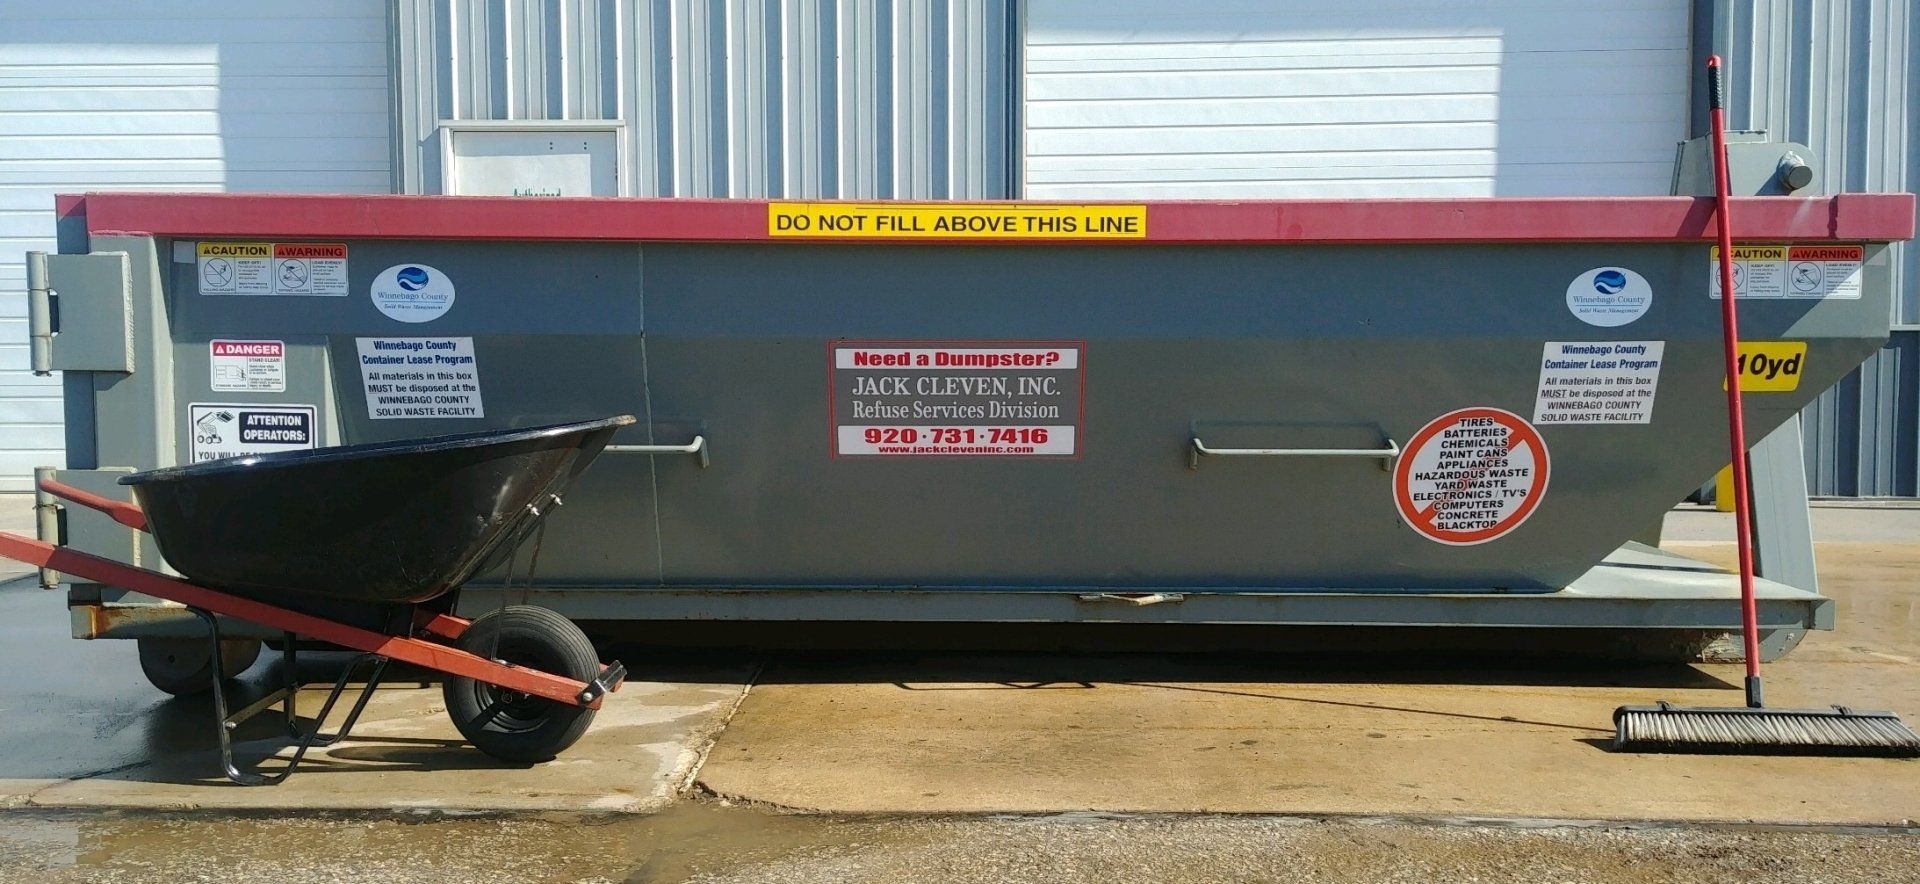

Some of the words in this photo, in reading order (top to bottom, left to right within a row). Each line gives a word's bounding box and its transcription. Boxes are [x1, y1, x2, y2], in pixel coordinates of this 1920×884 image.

[776, 215, 810, 231] DO
[819, 215, 868, 231] NOT
[876, 215, 925, 231] FILL
[933, 216, 1018, 232] ABOVE
[1023, 216, 1077, 233] THIS
[1086, 217, 1138, 233] LINE
[211, 246, 267, 255] CAUTION
[284, 247, 343, 256] WARNING
[1800, 250, 1858, 258] WARNING
[378, 292, 419, 301] Winnebago
[421, 292, 449, 301] County
[1573, 296, 1615, 304] Winnebago
[1617, 296, 1645, 304] County
[226, 345, 280, 355] DANGER
[374, 341, 423, 351] Winnebago
[426, 341, 456, 351] County
[1561, 345, 1612, 356] Winnebago
[1614, 344, 1647, 355] County
[362, 355, 404, 365] Container
[407, 355, 433, 364] Lease
[435, 355, 473, 366] Program
[854, 352, 911, 366] Need
[916, 355, 929, 366] a
[935, 351, 1060, 368] Dumpster?
[1544, 360, 1588, 369] Container
[1591, 360, 1617, 369] Lease
[1619, 359, 1658, 370] Program
[1738, 353, 1802, 380] 10yd
[368, 372, 380, 381] All
[382, 372, 424, 380] materials
[426, 372, 435, 380] in
[437, 372, 454, 380] this
[456, 372, 472, 380] box
[1545, 377, 1557, 386] All
[1559, 377, 1602, 385] materials
[1604, 377, 1613, 385] in
[1616, 376, 1633, 385] this
[1635, 376, 1651, 385] box
[368, 384, 393, 393] MUST
[396, 384, 407, 392] be
[409, 384, 449, 394] disposed
[462, 384, 476, 392] the
[852, 377, 912, 396] JACK
[916, 376, 1013, 399] CLEVEN,
[1017, 377, 1061, 396] INC.
[1541, 389, 1567, 398] MUST
[1569, 389, 1580, 398] be
[1582, 389, 1624, 399] disposed
[1626, 389, 1636, 397] at
[1637, 389, 1651, 397] the
[378, 396, 432, 404] WINNEBAGO
[435, 396, 470, 404] COUNTY
[1547, 401, 1603, 409] WINNEBAGO
[1605, 401, 1642, 409] COUNTY
[376, 408, 402, 416] SOLID
[404, 408, 435, 416] WASTE
[438, 408, 476, 416] FACILITY
[852, 401, 909, 418] Refuse
[913, 400, 985, 418] Services
[988, 400, 1060, 418] Division
[247, 415, 302, 426] ATTENTION
[1460, 418, 1494, 427] TIRES
[1541, 413, 1567, 422] SOLID
[1570, 413, 1601, 421] WASTE
[1604, 413, 1644, 421] FACILITY
[243, 430, 306, 441] OPERATORS:
[1444, 428, 1507, 438] BATTERIES
[1441, 438, 1508, 449] CHEMICALS
[878, 445, 1034, 454] www.jackcleveninc.com
[1439, 450, 1473, 460] PAINT
[1476, 449, 1508, 458] CANS
[199, 451, 216, 460] YOU
[217, 451, 236, 459] WILL
[1436, 459, 1509, 470] APPLIANCES
[1415, 470, 1486, 480] HAZARDOUS
[1489, 468, 1529, 478] WASTE
[1435, 481, 1466, 490] YARD
[1468, 480, 1507, 489] WASTE
[1413, 490, 1492, 501] ELECTRONICS
[1502, 489, 1527, 498] TV'S
[1434, 500, 1504, 510] COMPUTERS
[1437, 510, 1499, 520] CONCRETE
[1437, 520, 1497, 530] BLACKTOP
